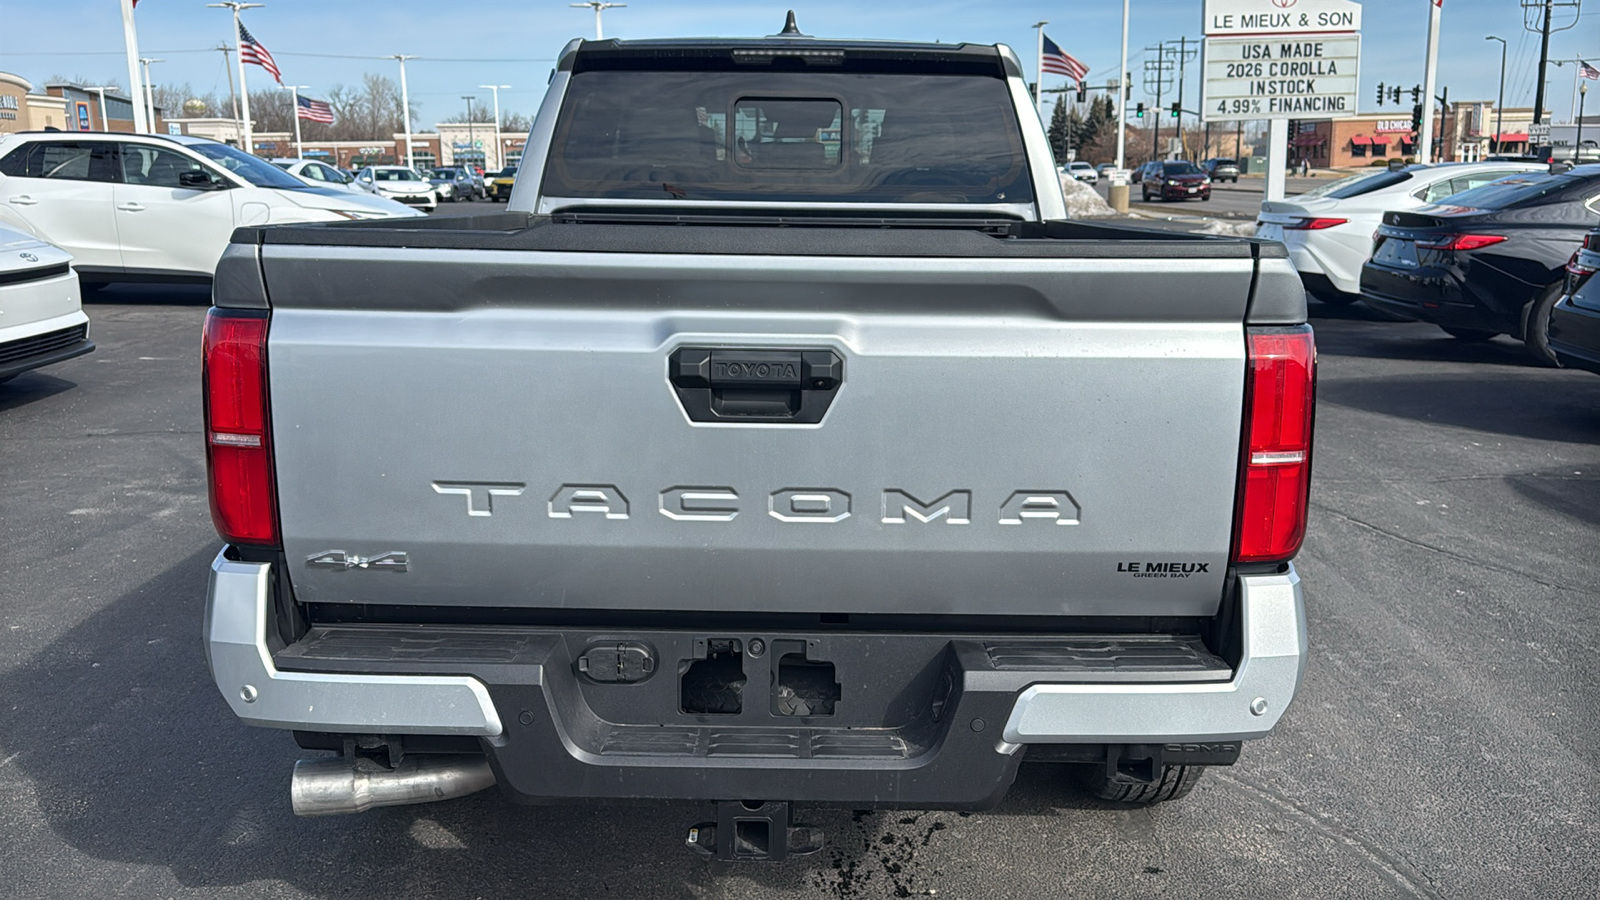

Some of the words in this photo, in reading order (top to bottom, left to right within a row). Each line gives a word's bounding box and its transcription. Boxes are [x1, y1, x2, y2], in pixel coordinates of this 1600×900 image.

[1214, 15, 1233, 28] LE
[1241, 13, 1291, 28] MIEUX
[1298, 13, 1309, 27] &
[1318, 12, 1353, 26] SON
[1242, 44, 1271, 59] USA
[1280, 43, 1323, 58] MADE
[1227, 63, 1263, 78] 2026
[1269, 61, 1337, 76] COROLLA
[1217, 99, 1261, 114] 4.99%
[1269, 96, 1346, 113] FINANCING
[715, 362, 797, 378] TOYOTA
[431, 480, 1081, 525] TACOMA
[1117, 562, 1140, 572] LE
[1145, 562, 1210, 573] MIEUX
